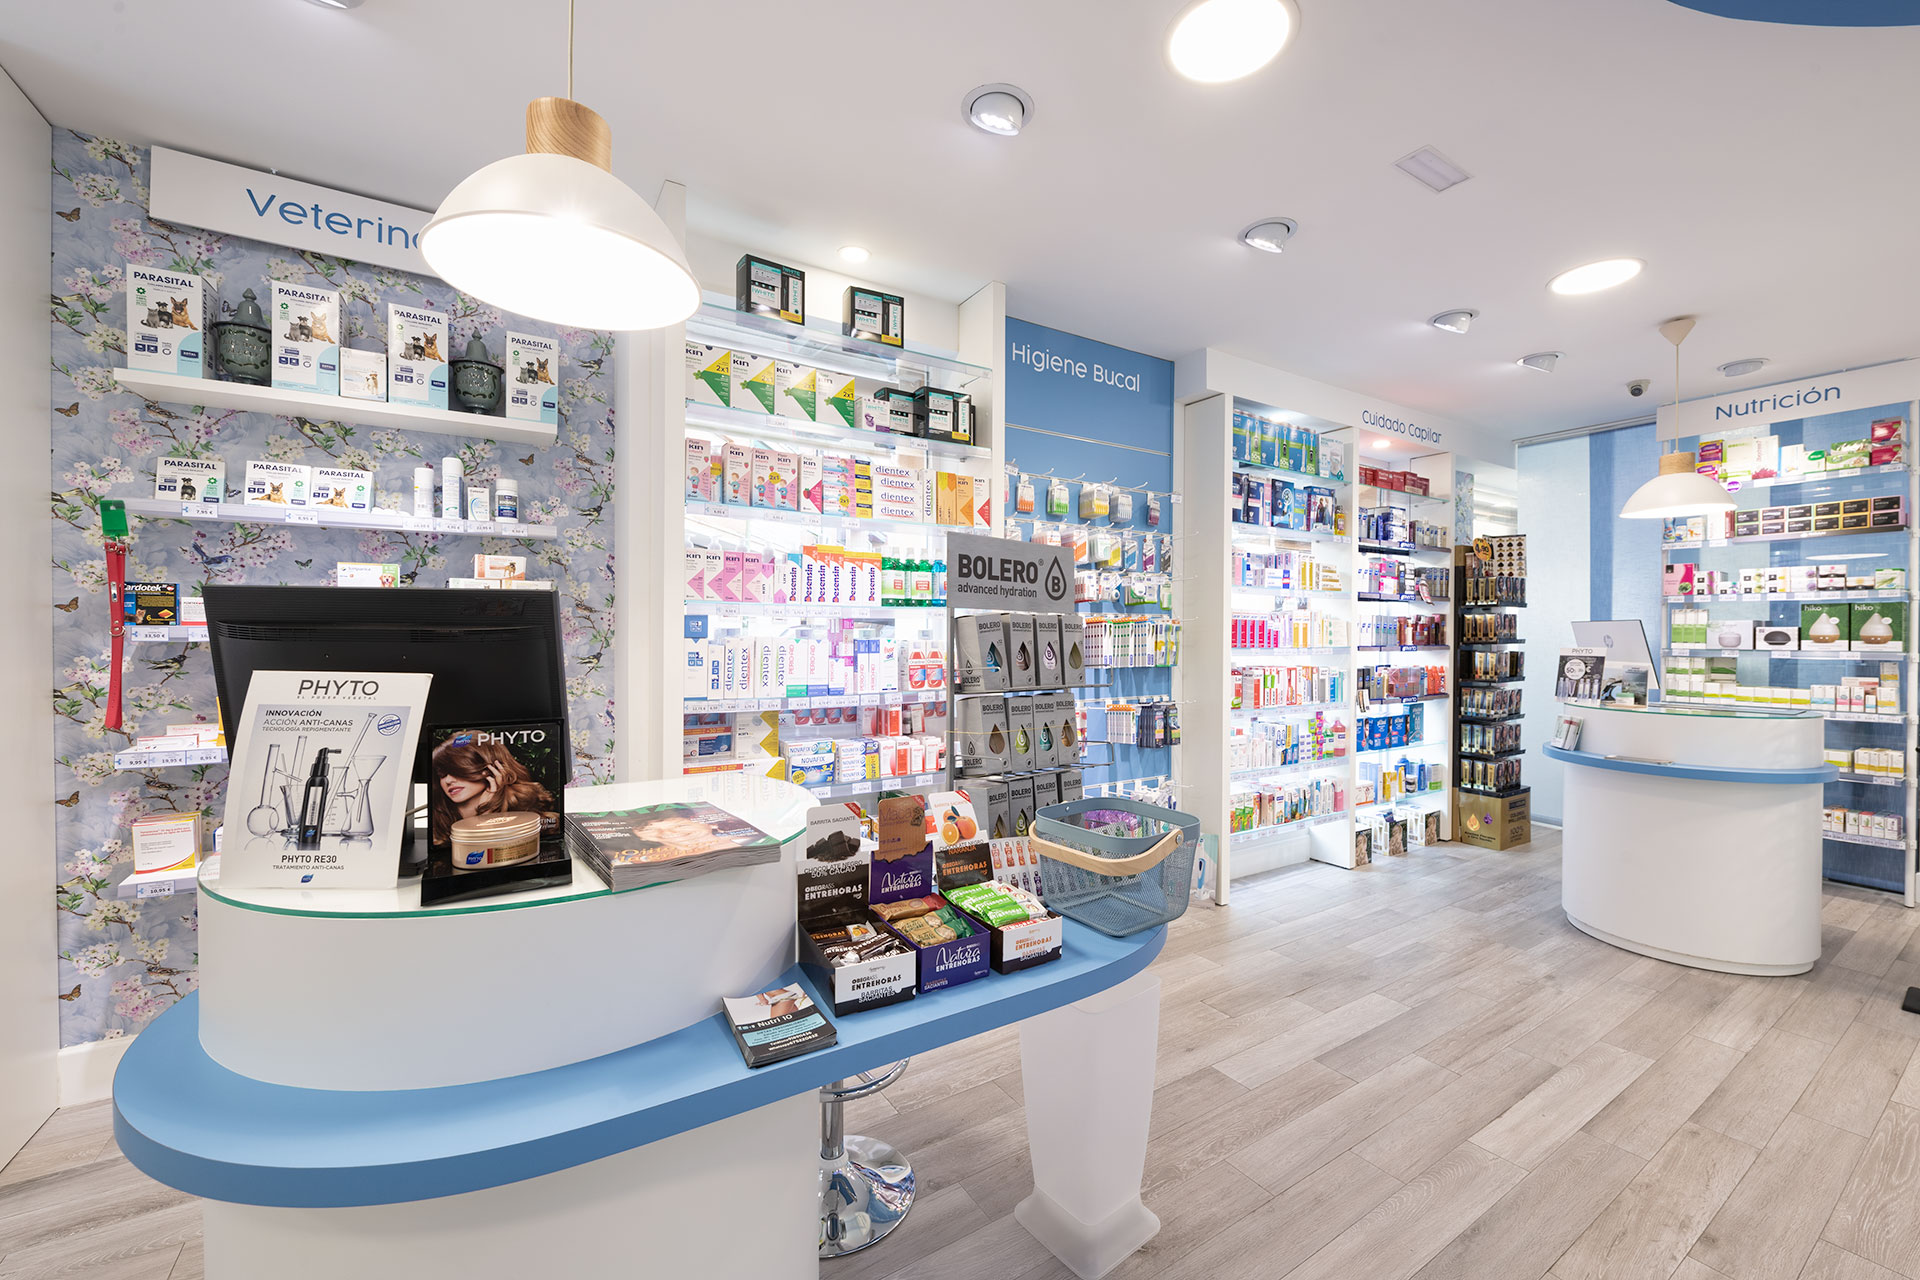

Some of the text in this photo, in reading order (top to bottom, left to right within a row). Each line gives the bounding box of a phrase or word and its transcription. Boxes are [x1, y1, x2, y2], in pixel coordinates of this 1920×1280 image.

[132, 271, 195, 288] PARASITAL
[277, 287, 333, 304] PARASITAL
[393, 309, 443, 327] PARASITAL
[510, 336, 554, 351] PARASITAL
[715, 364, 730, 374] 2x1
[1012, 342, 1140, 393] Higiene Bucal
[842, 390, 854, 399] 2x1
[1715, 385, 1842, 421] Nutrición
[1361, 409, 1442, 445] Cuidado Capilar
[163, 459, 218, 471] PARASITAL
[252, 463, 304, 474] PARASITAL
[875, 464, 910, 476] dientex
[319, 468, 366, 479] PARASITAL
[769, 473, 780, 481] 2x1
[880, 477, 915, 489] dientex
[880, 491, 915, 503] dientex
[880, 505, 915, 517] dientex
[957, 553, 1039, 585] BOLERO
[957, 582, 1038, 598] advanced hydration
[978, 621, 1001, 631] BOLERO
[1011, 621, 1031, 629] BOLERO
[1038, 622, 1057, 630] BOLERO
[1064, 622, 1082, 630] BOLERO
[725, 648, 733, 691] dientex
[739, 647, 748, 690] dientex
[763, 645, 771, 688] dientex
[778, 645, 786, 687] dientex
[297, 679, 380, 697] PHYTO
[982, 703, 1004, 712] BOLERO
[1011, 704, 1032, 713] BOLERO
[1034, 702, 1054, 711] BOLERO
[1055, 700, 1075, 708] BOLERO
[265, 708, 323, 717] INNOVACIÓN
[263, 717, 298, 726] ACCIÓN
[298, 718, 354, 727] ANTI-CANAS
[477, 729, 546, 747] PHYTO
[801, 756, 826, 764] NOVAFIX
[1036, 781, 1056, 792] BOLERO
[1063, 778, 1082, 788] BOLERO
[989, 792, 1008, 802] BOLERO
[1011, 788, 1032, 798] BOLERO
[810, 815, 856, 827] BARRITA SACIANTE
[948, 844, 977, 856] NARANJA
[281, 854, 338, 864] PHYTO RE30
[829, 865, 857, 876] CACAO
[942, 861, 988, 877] ENTREHORAS
[881, 870, 923, 888] Natura
[804, 882, 836, 893] OBEGRASS
[804, 884, 863, 901] ENTREHORAS
[881, 880, 922, 894] ENTREHORAS
[1015, 935, 1053, 951] ENTREHORAS
[936, 945, 981, 967] Natura
[935, 955, 981, 973] ENTREHORAS
[851, 974, 903, 992] ENTREHORAS
[860, 985, 894, 997] BARRITAS
[757, 1015, 781, 1028] Nutri
[782, 1014, 793, 1022] 10
